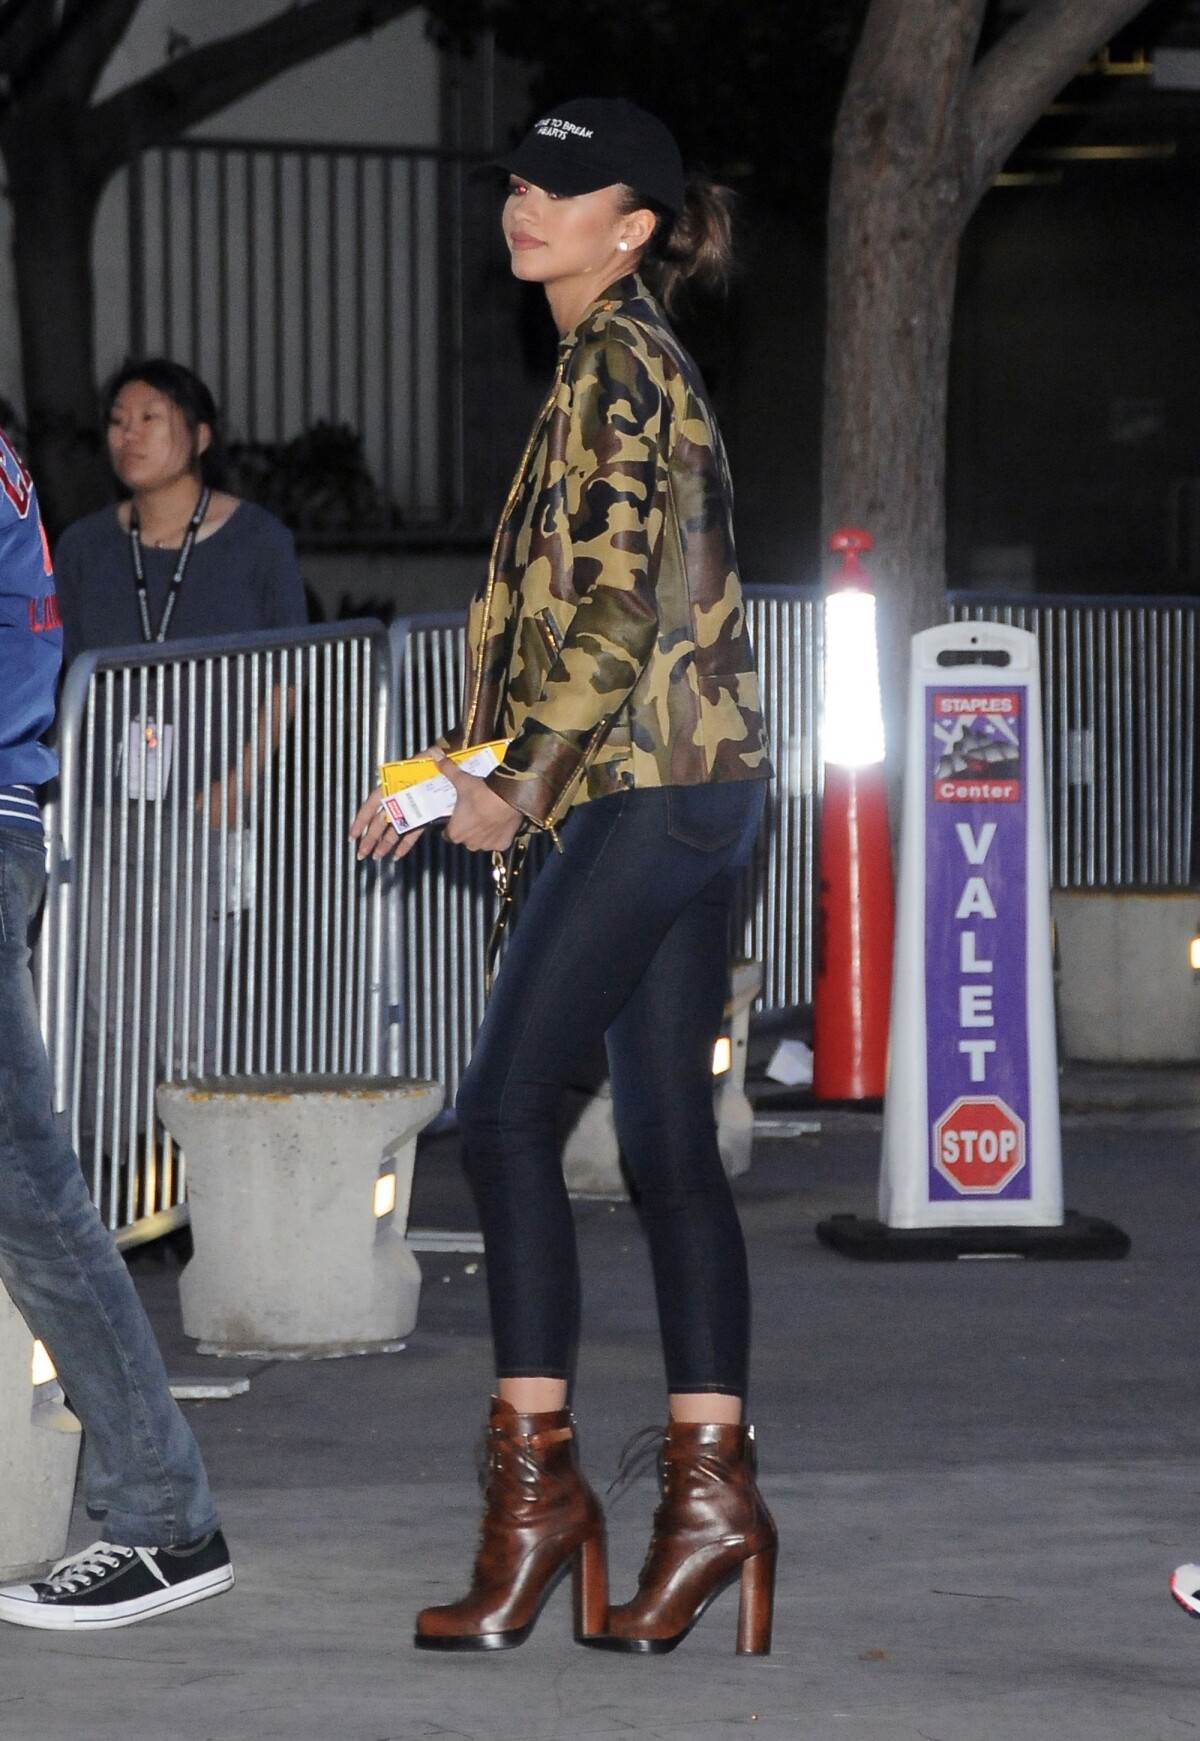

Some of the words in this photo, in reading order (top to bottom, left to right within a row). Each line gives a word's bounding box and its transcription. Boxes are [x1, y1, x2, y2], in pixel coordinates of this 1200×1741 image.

[551, 118, 563, 127] TO
[563, 121, 593, 138] BREAK
[940, 697, 1013, 713] STAPLES
[940, 783, 1013, 798] Center
[955, 822, 997, 1082] VALET
[941, 1129, 1018, 1164] STOP
